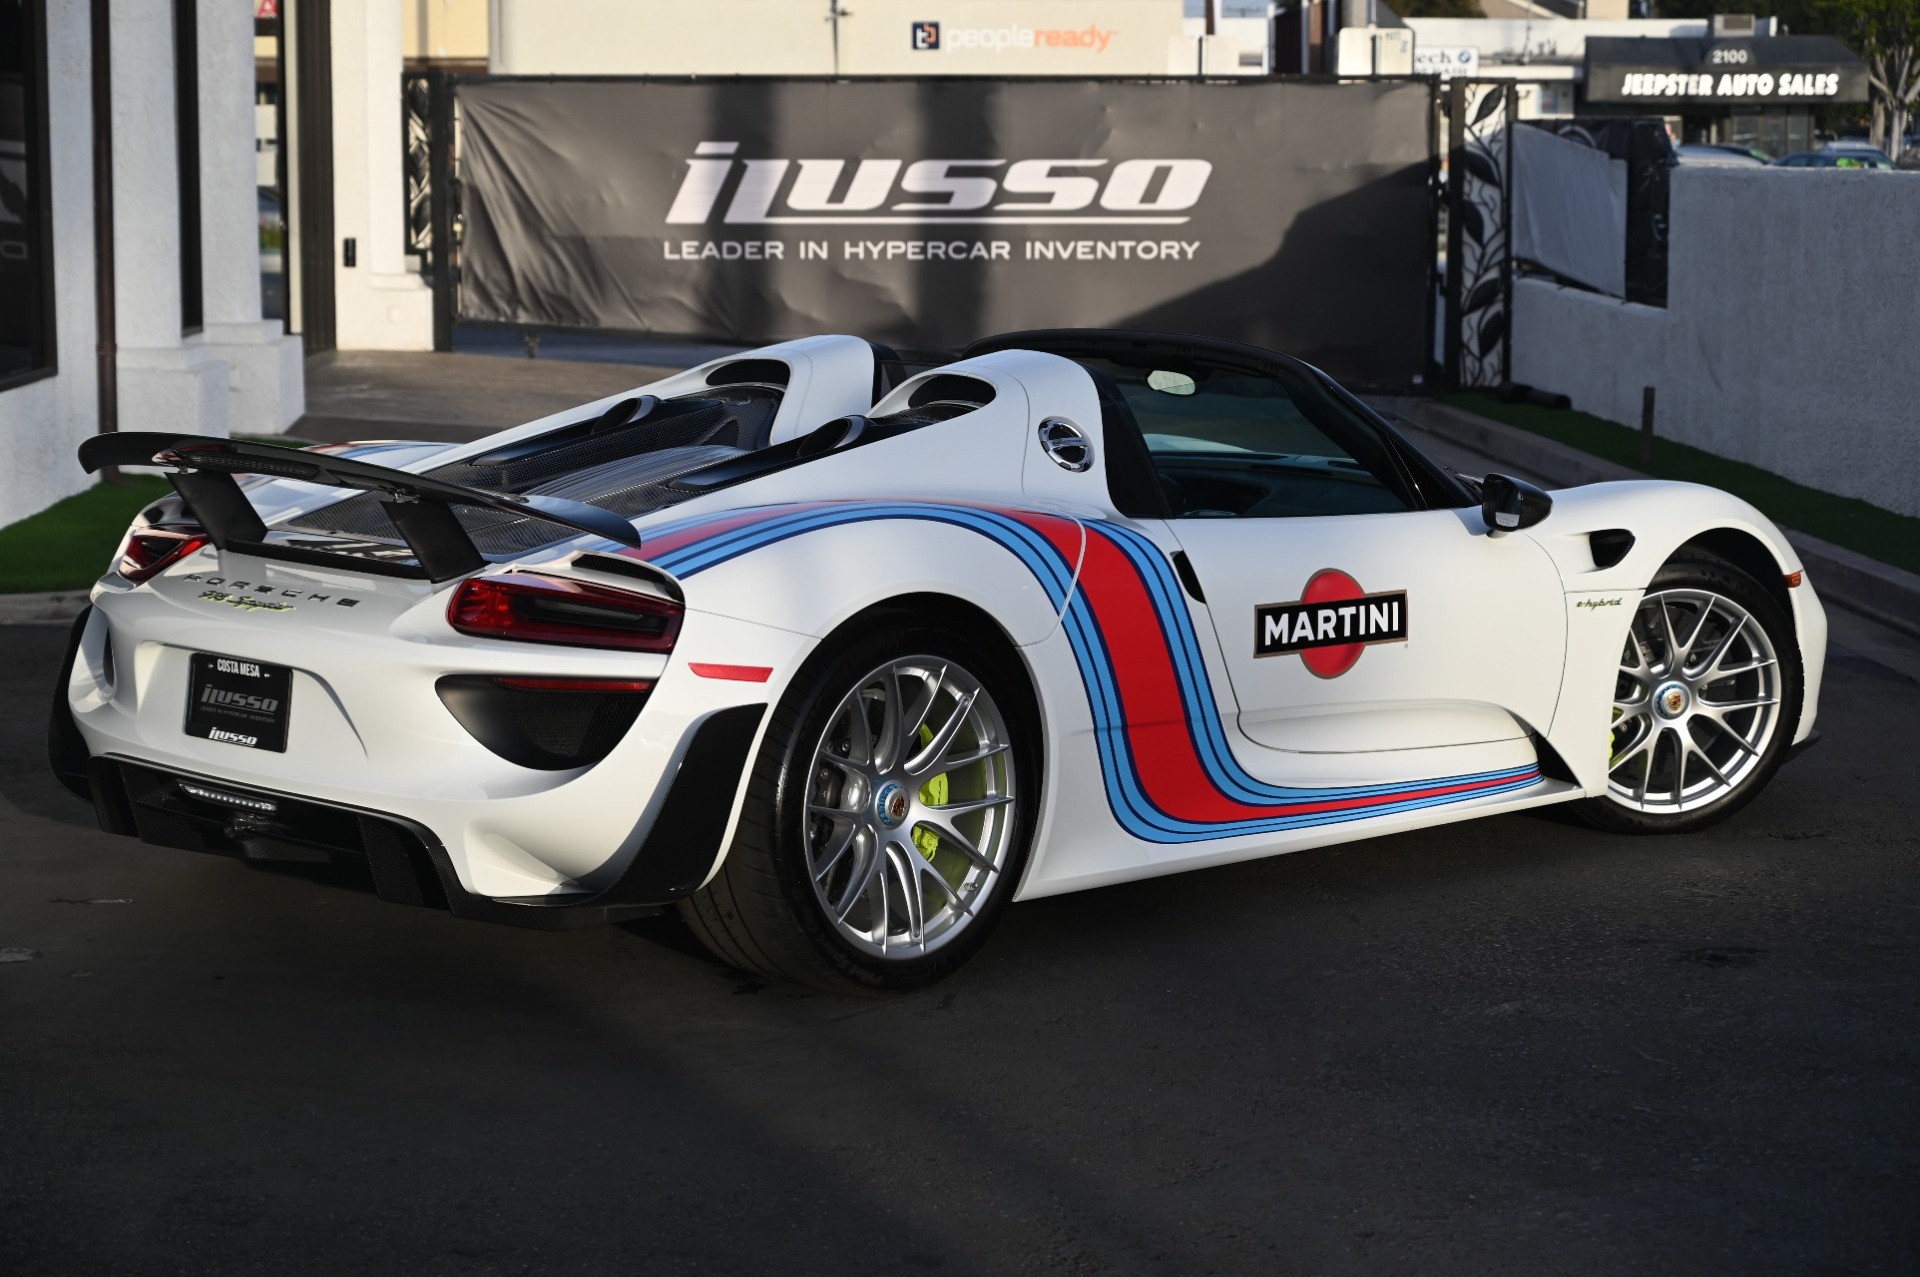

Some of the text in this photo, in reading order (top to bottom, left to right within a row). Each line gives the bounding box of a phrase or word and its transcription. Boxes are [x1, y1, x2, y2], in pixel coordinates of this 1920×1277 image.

[1712, 49, 1748, 64] 2100
[1621, 73, 1839, 96] JEEPSTER AUTO SALES
[664, 241, 1200, 260] LEADER IN HYPERCAR INVENTORY
[184, 574, 360, 608] PORSCHE
[1264, 601, 1399, 646] MARTINI
[217, 658, 261, 678] COSTA MESA
